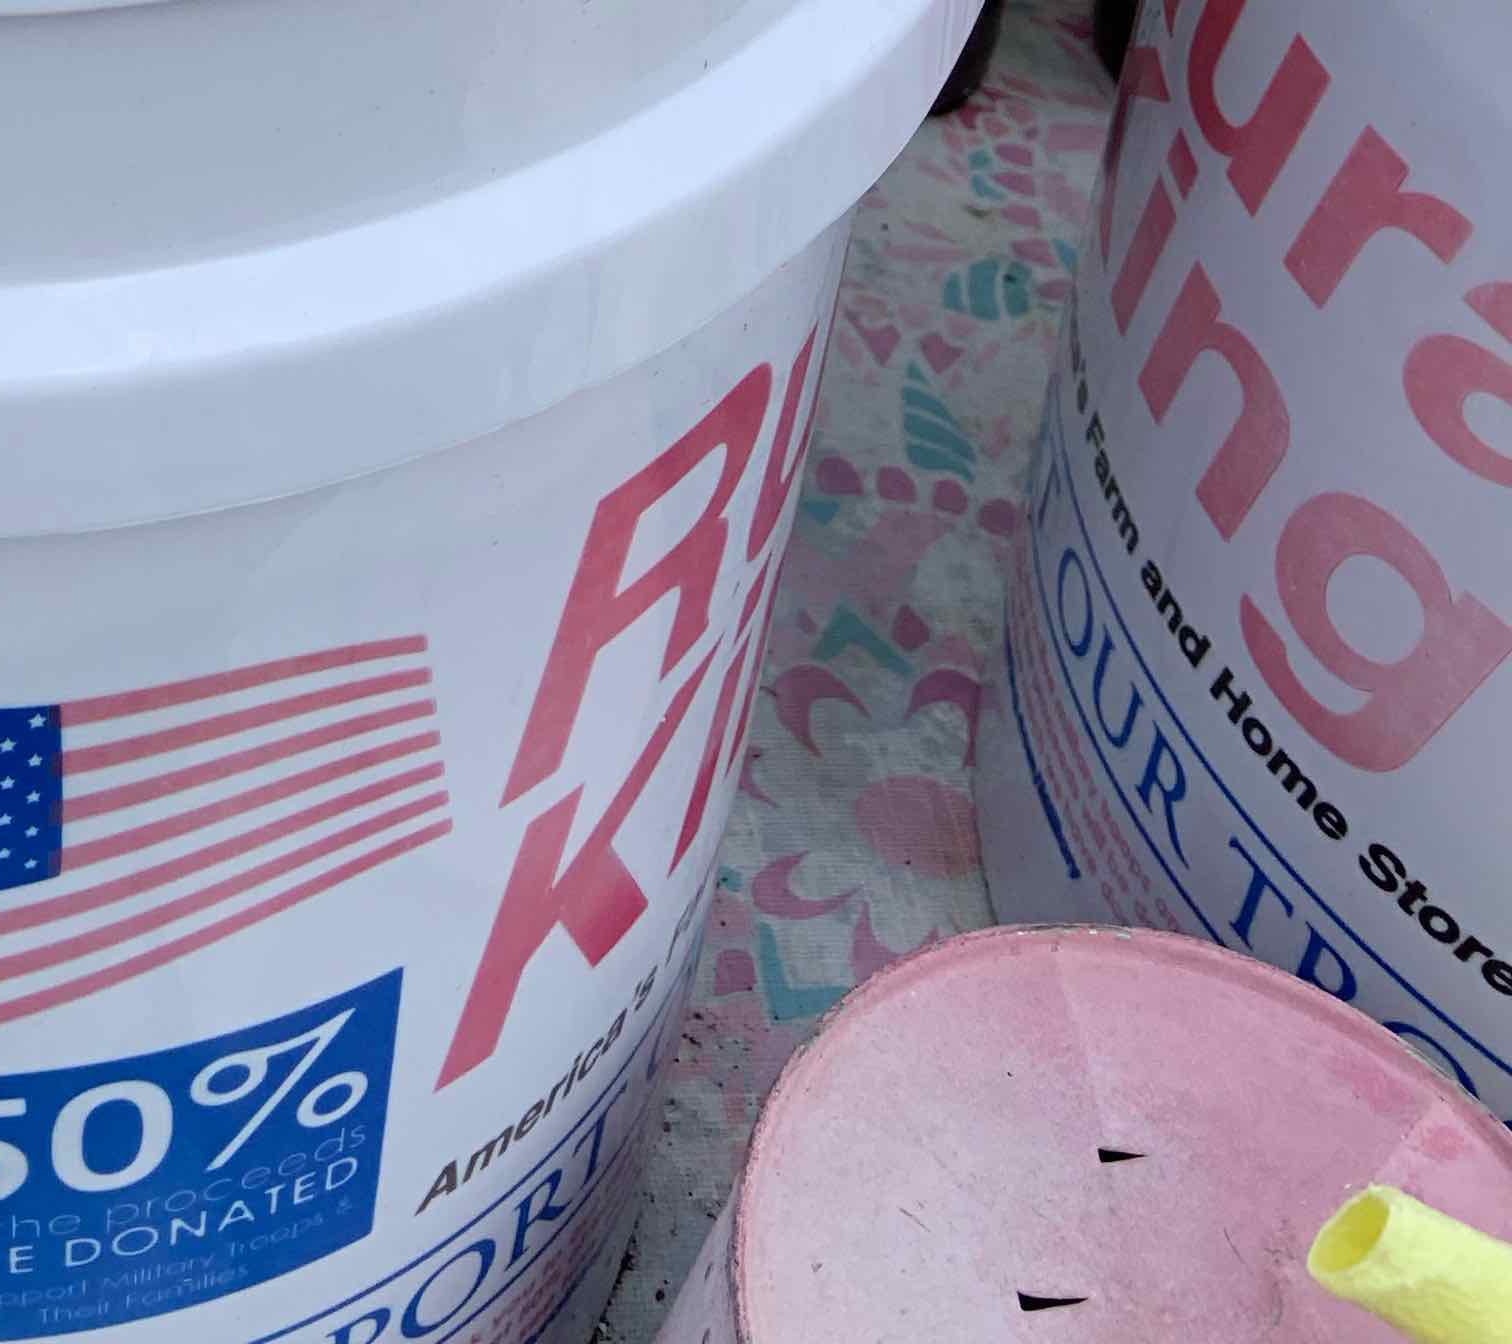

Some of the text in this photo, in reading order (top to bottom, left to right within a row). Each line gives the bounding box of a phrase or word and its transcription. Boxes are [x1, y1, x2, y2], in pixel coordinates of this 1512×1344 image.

[1086, 412, 1139, 555] Farm
[1141, 558, 1212, 669] and
[1209, 666, 1349, 841] Home
[1057, 545, 1189, 870] OUR
[414, 964, 660, 1217] America's
[65, 1158, 358, 1267] DONATED
[105, 1123, 366, 1233] proceeds
[39, 1264, 250, 1325] Their Families
[101, 1254, 215, 1292] Military
[228, 1212, 325, 1258] Troops
